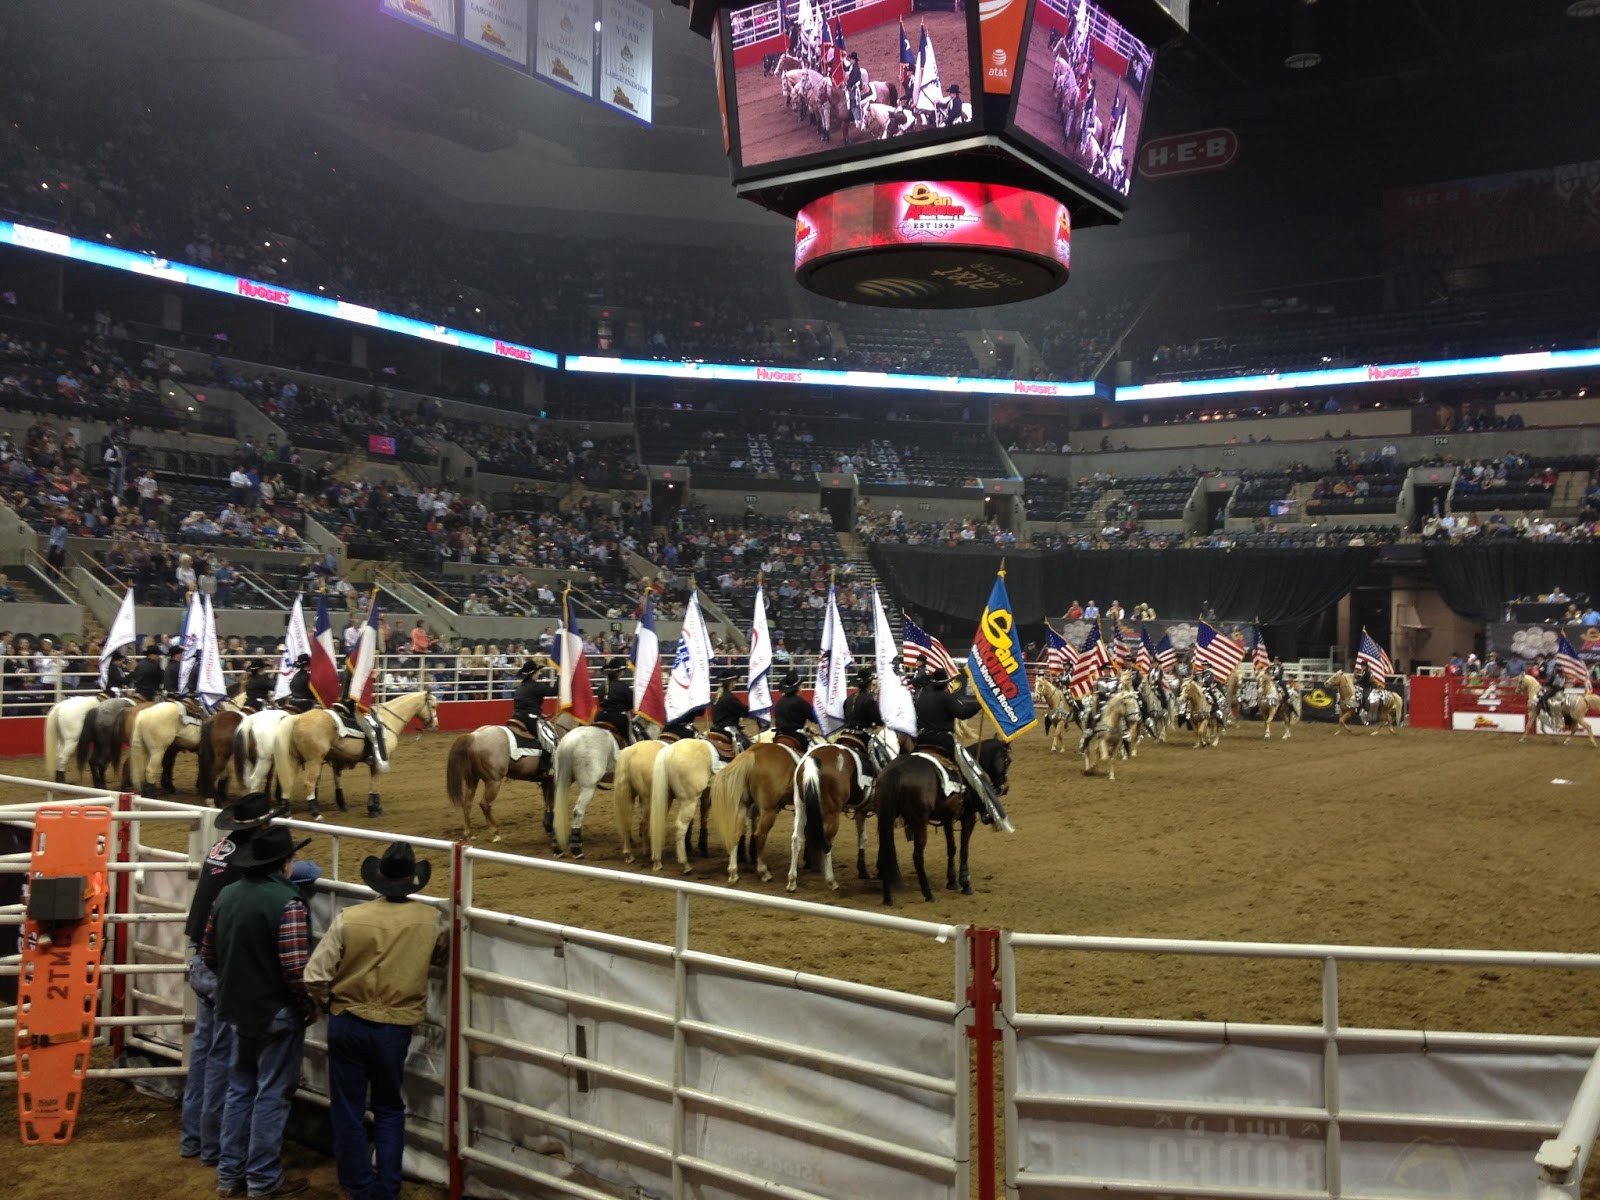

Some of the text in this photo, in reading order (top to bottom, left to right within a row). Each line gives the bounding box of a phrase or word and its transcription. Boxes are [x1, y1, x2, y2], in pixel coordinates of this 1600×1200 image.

[471, 2, 494, 19] LARGE
[615, 24, 639, 44] YEAR
[564, 48, 589, 66] INDOOR
[619, 62, 635, 78] 2012
[988, 67, 1008, 78] at&t
[624, 78, 648, 95] INDOOR
[981, 605, 1020, 675] San
[979, 665, 998, 690] Show
[997, 694, 1019, 724] Rodeo
